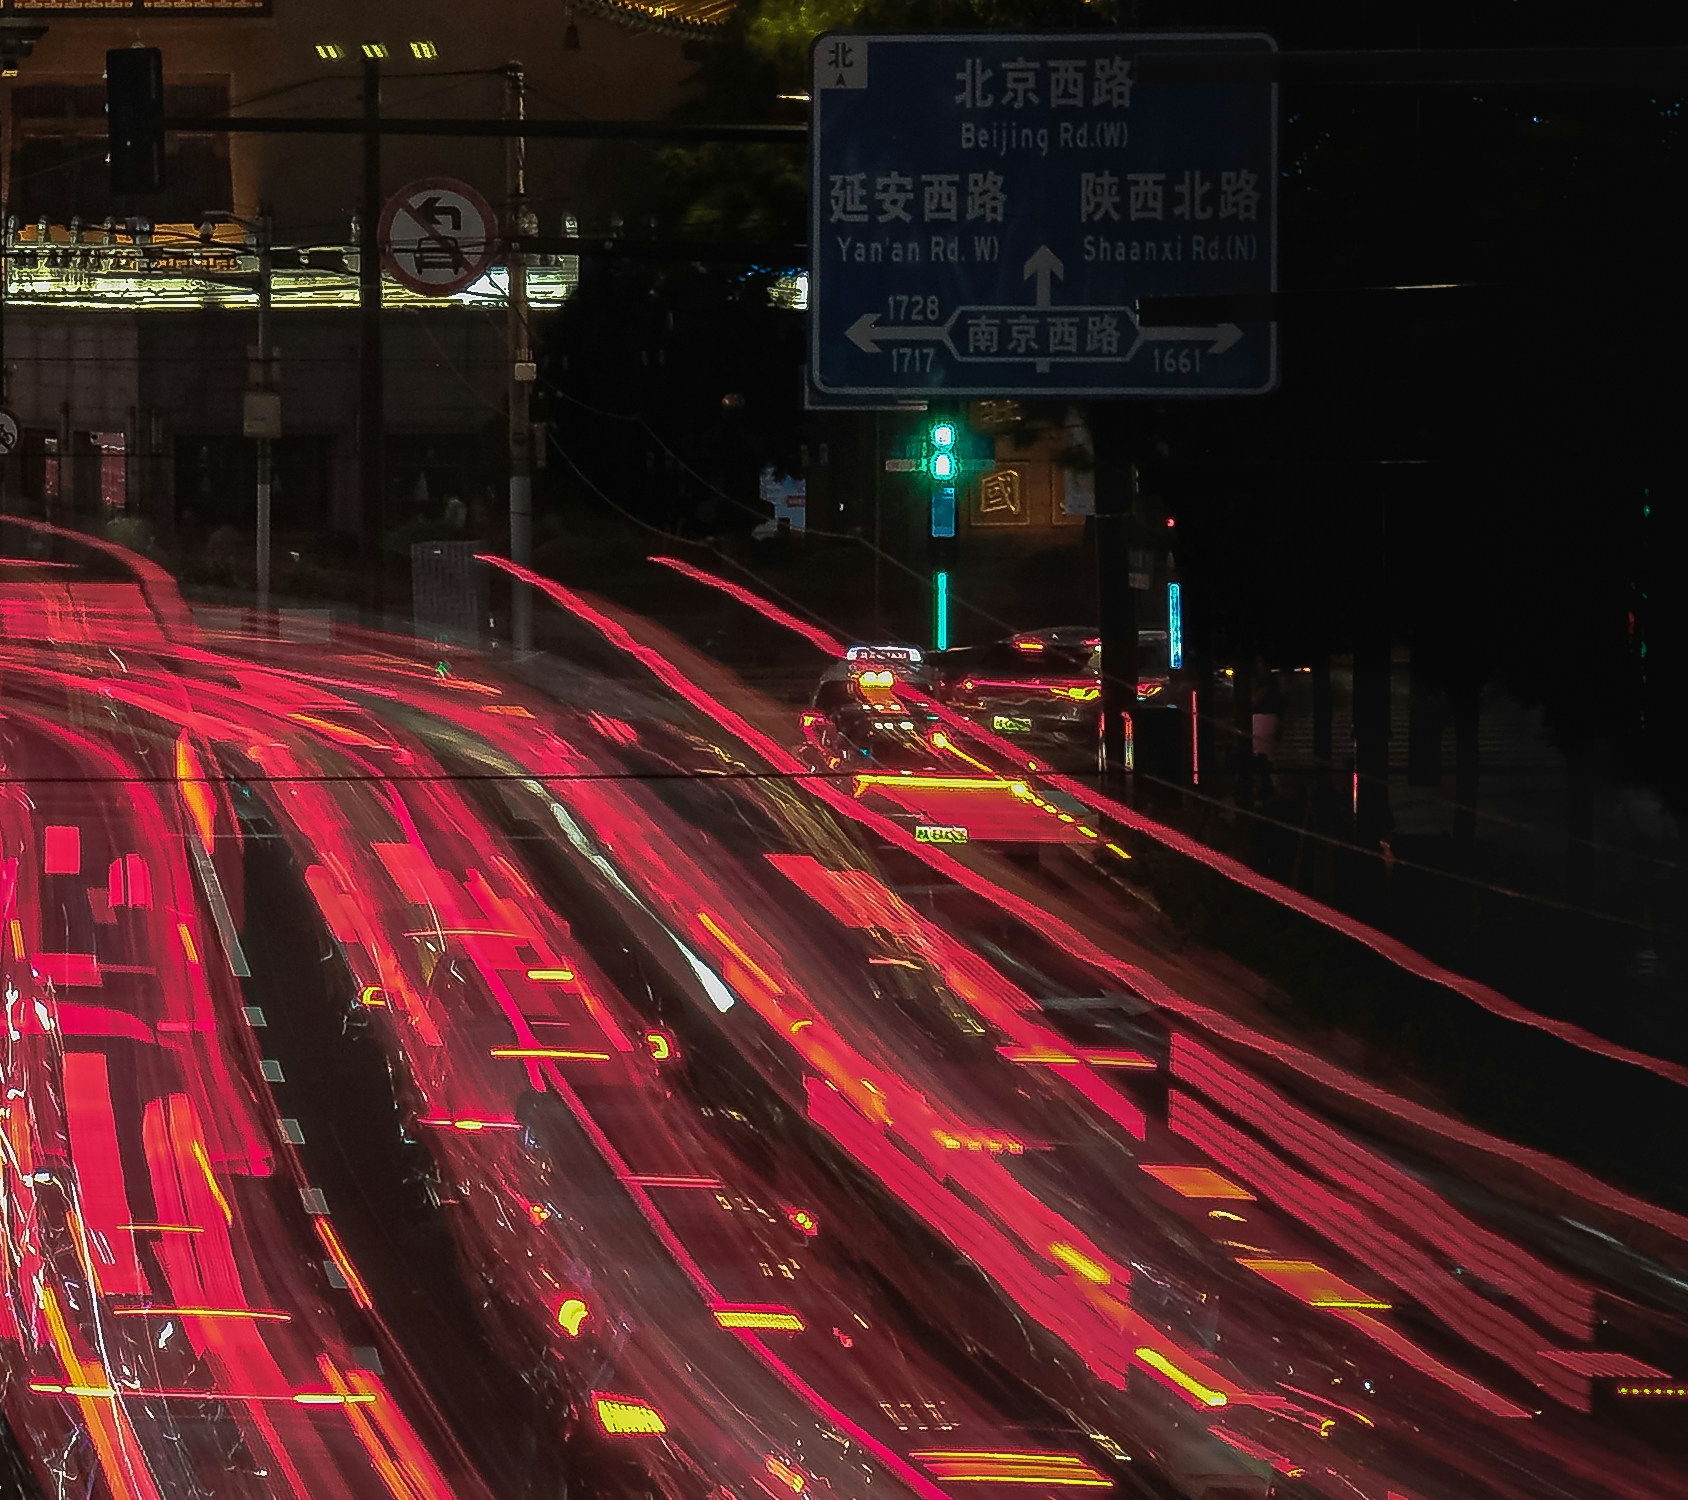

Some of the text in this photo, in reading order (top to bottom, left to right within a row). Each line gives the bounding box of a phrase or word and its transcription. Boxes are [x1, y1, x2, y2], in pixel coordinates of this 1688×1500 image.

[828, 42, 854, 68] 北
[955, 56, 1135, 109] 北京西路
[961, 121, 1129, 157] Beijing Rd.(W)
[828, 170, 1008, 224] 延安西路
[1080, 169, 1262, 223] 陕西北路
[836, 235, 920, 263] Yan'an
[1083, 234, 1258, 262] Shaanxi Rd.(N)
[888, 295, 940, 321] 1728
[967, 314, 1121, 353] 南京西路
[891, 348, 936, 373] 1717
[1153, 348, 1200, 374] 1661
